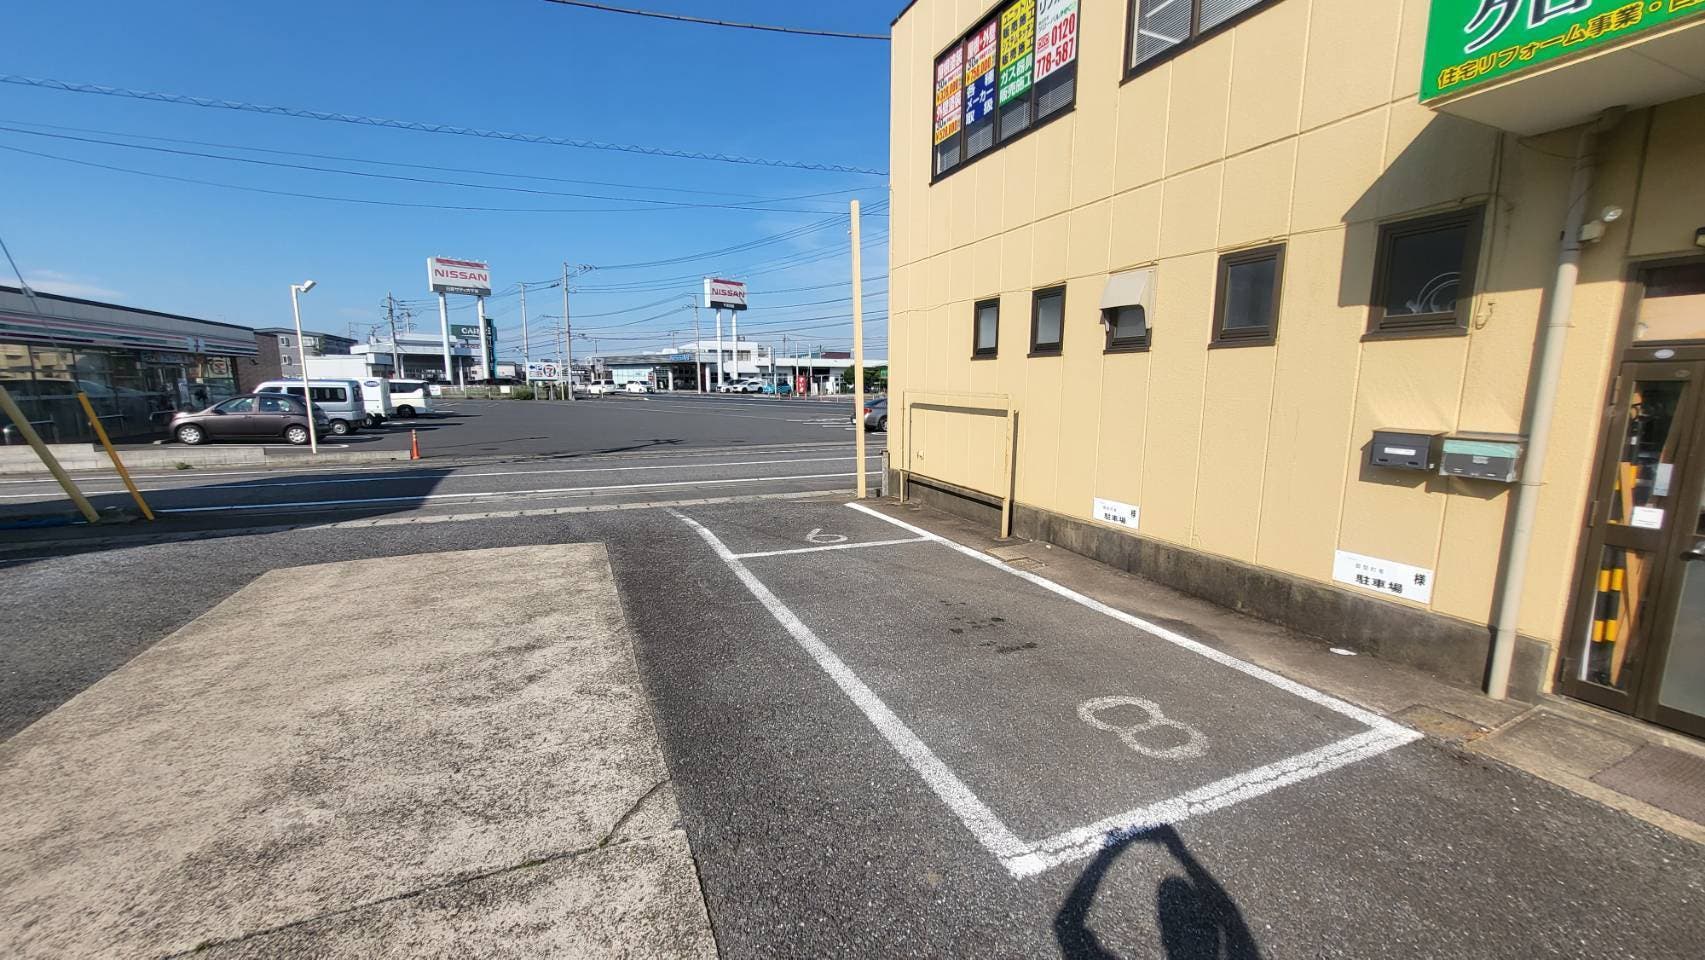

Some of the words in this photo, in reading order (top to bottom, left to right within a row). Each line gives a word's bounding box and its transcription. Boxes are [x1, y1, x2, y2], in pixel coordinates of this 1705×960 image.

[1051, 12, 1075, 46] 0120
[1036, 36, 1074, 79] 778-587
[967, 88, 994, 112] メーカー
[434, 269, 488, 282] NISSAN
[711, 287, 745, 298] NISSAN
[1103, 512, 1126, 524] 駐車場
[1355, 573, 1403, 594] 駐車場
[1414, 572, 1426, 586] 様
[1077, 696, 1209, 759] 8
